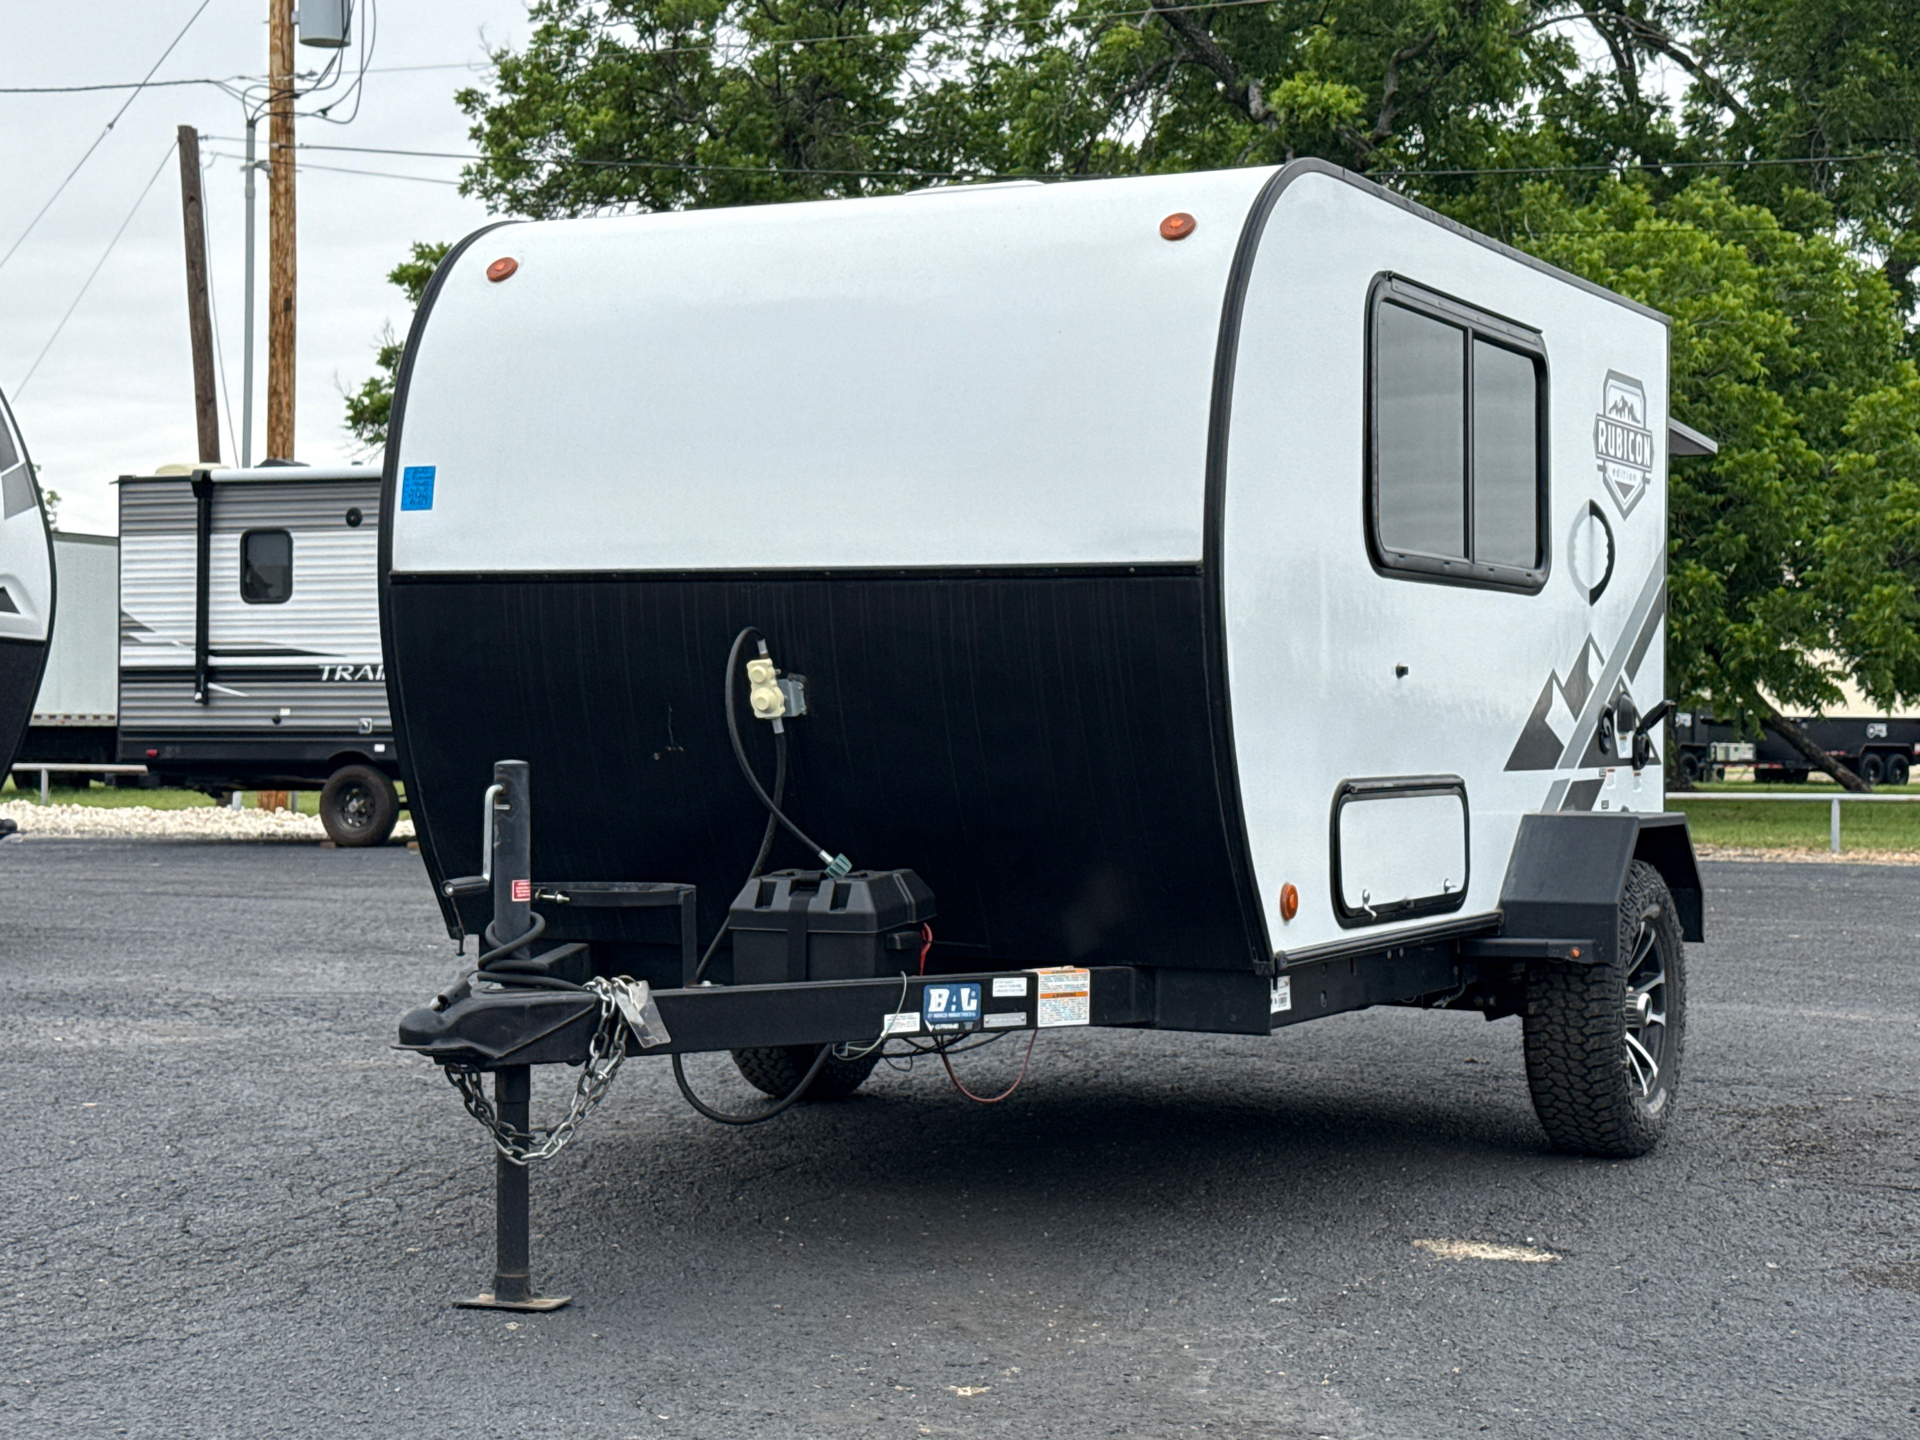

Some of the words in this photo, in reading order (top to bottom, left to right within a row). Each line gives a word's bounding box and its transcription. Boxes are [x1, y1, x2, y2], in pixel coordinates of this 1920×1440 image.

[1598, 420, 1651, 467] RUBICON
[1612, 467, 1637, 481] edition
[928, 987, 978, 1012] BAL
